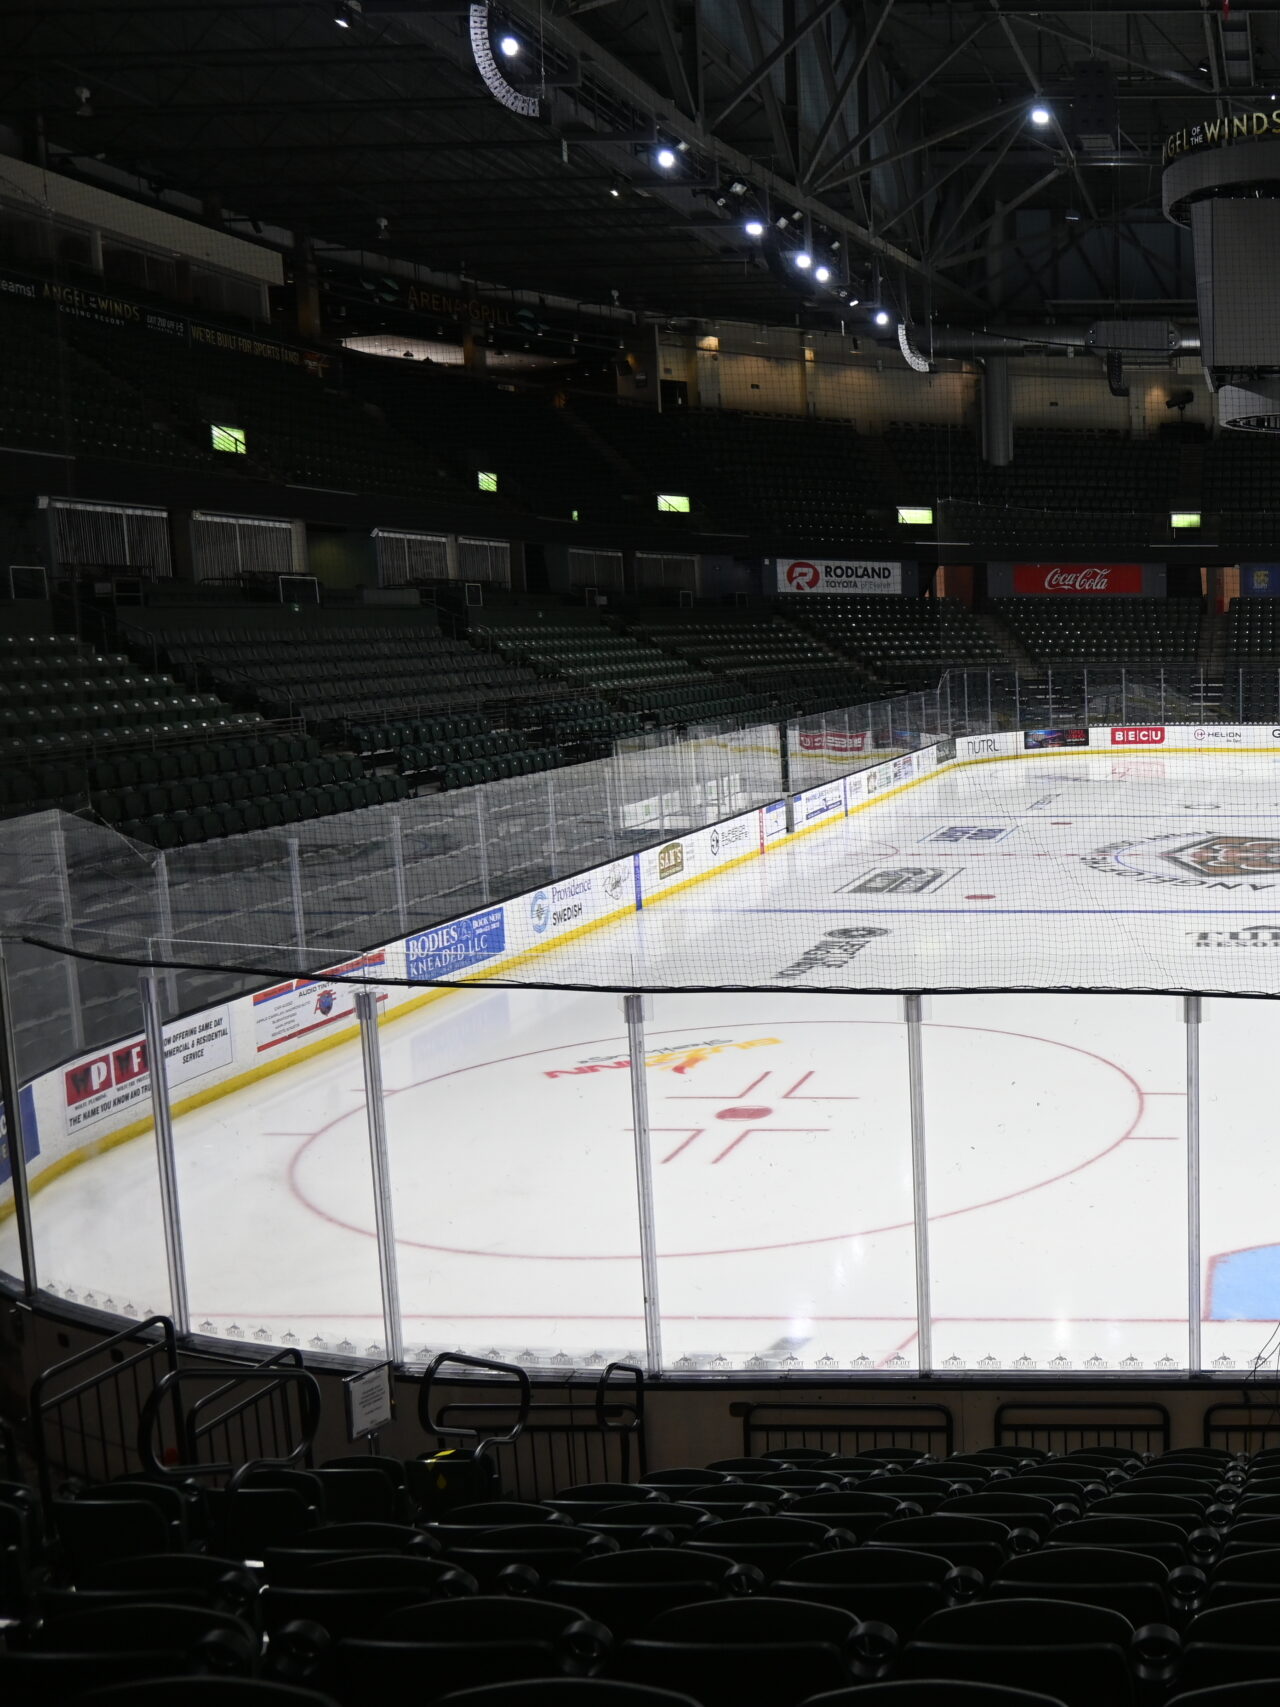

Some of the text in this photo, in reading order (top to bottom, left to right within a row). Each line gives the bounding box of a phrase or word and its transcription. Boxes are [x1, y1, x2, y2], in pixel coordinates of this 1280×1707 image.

[97, 295, 141, 322] WINDS
[824, 565, 891, 579] RODLAND
[825, 580, 858, 589] TOYOTA
[1044, 568, 1112, 590] Coca-Cola
[551, 879, 593, 904] Providence
[552, 903, 583, 926] SWEDISH
[409, 925, 458, 961] BODIES
[409, 943, 466, 977] KNEADED
[468, 934, 488, 957] LLC
[298, 987, 317, 998] AUDIO
[172, 1027, 197, 1043] OFFERING
[198, 1020, 213, 1034] SAME
[213, 1017, 223, 1028] DAY
[164, 1042, 190, 1059] MMERCIAL
[196, 1028, 228, 1046] RESIDENTIAL
[182, 1048, 204, 1064] SERVICE
[69, 1113, 82, 1127] THE
[82, 1106, 100, 1121] NAME
[100, 1102, 112, 1113] YOU
[112, 1094, 130, 1107] KNOW
[130, 1088, 140, 1100] AND
